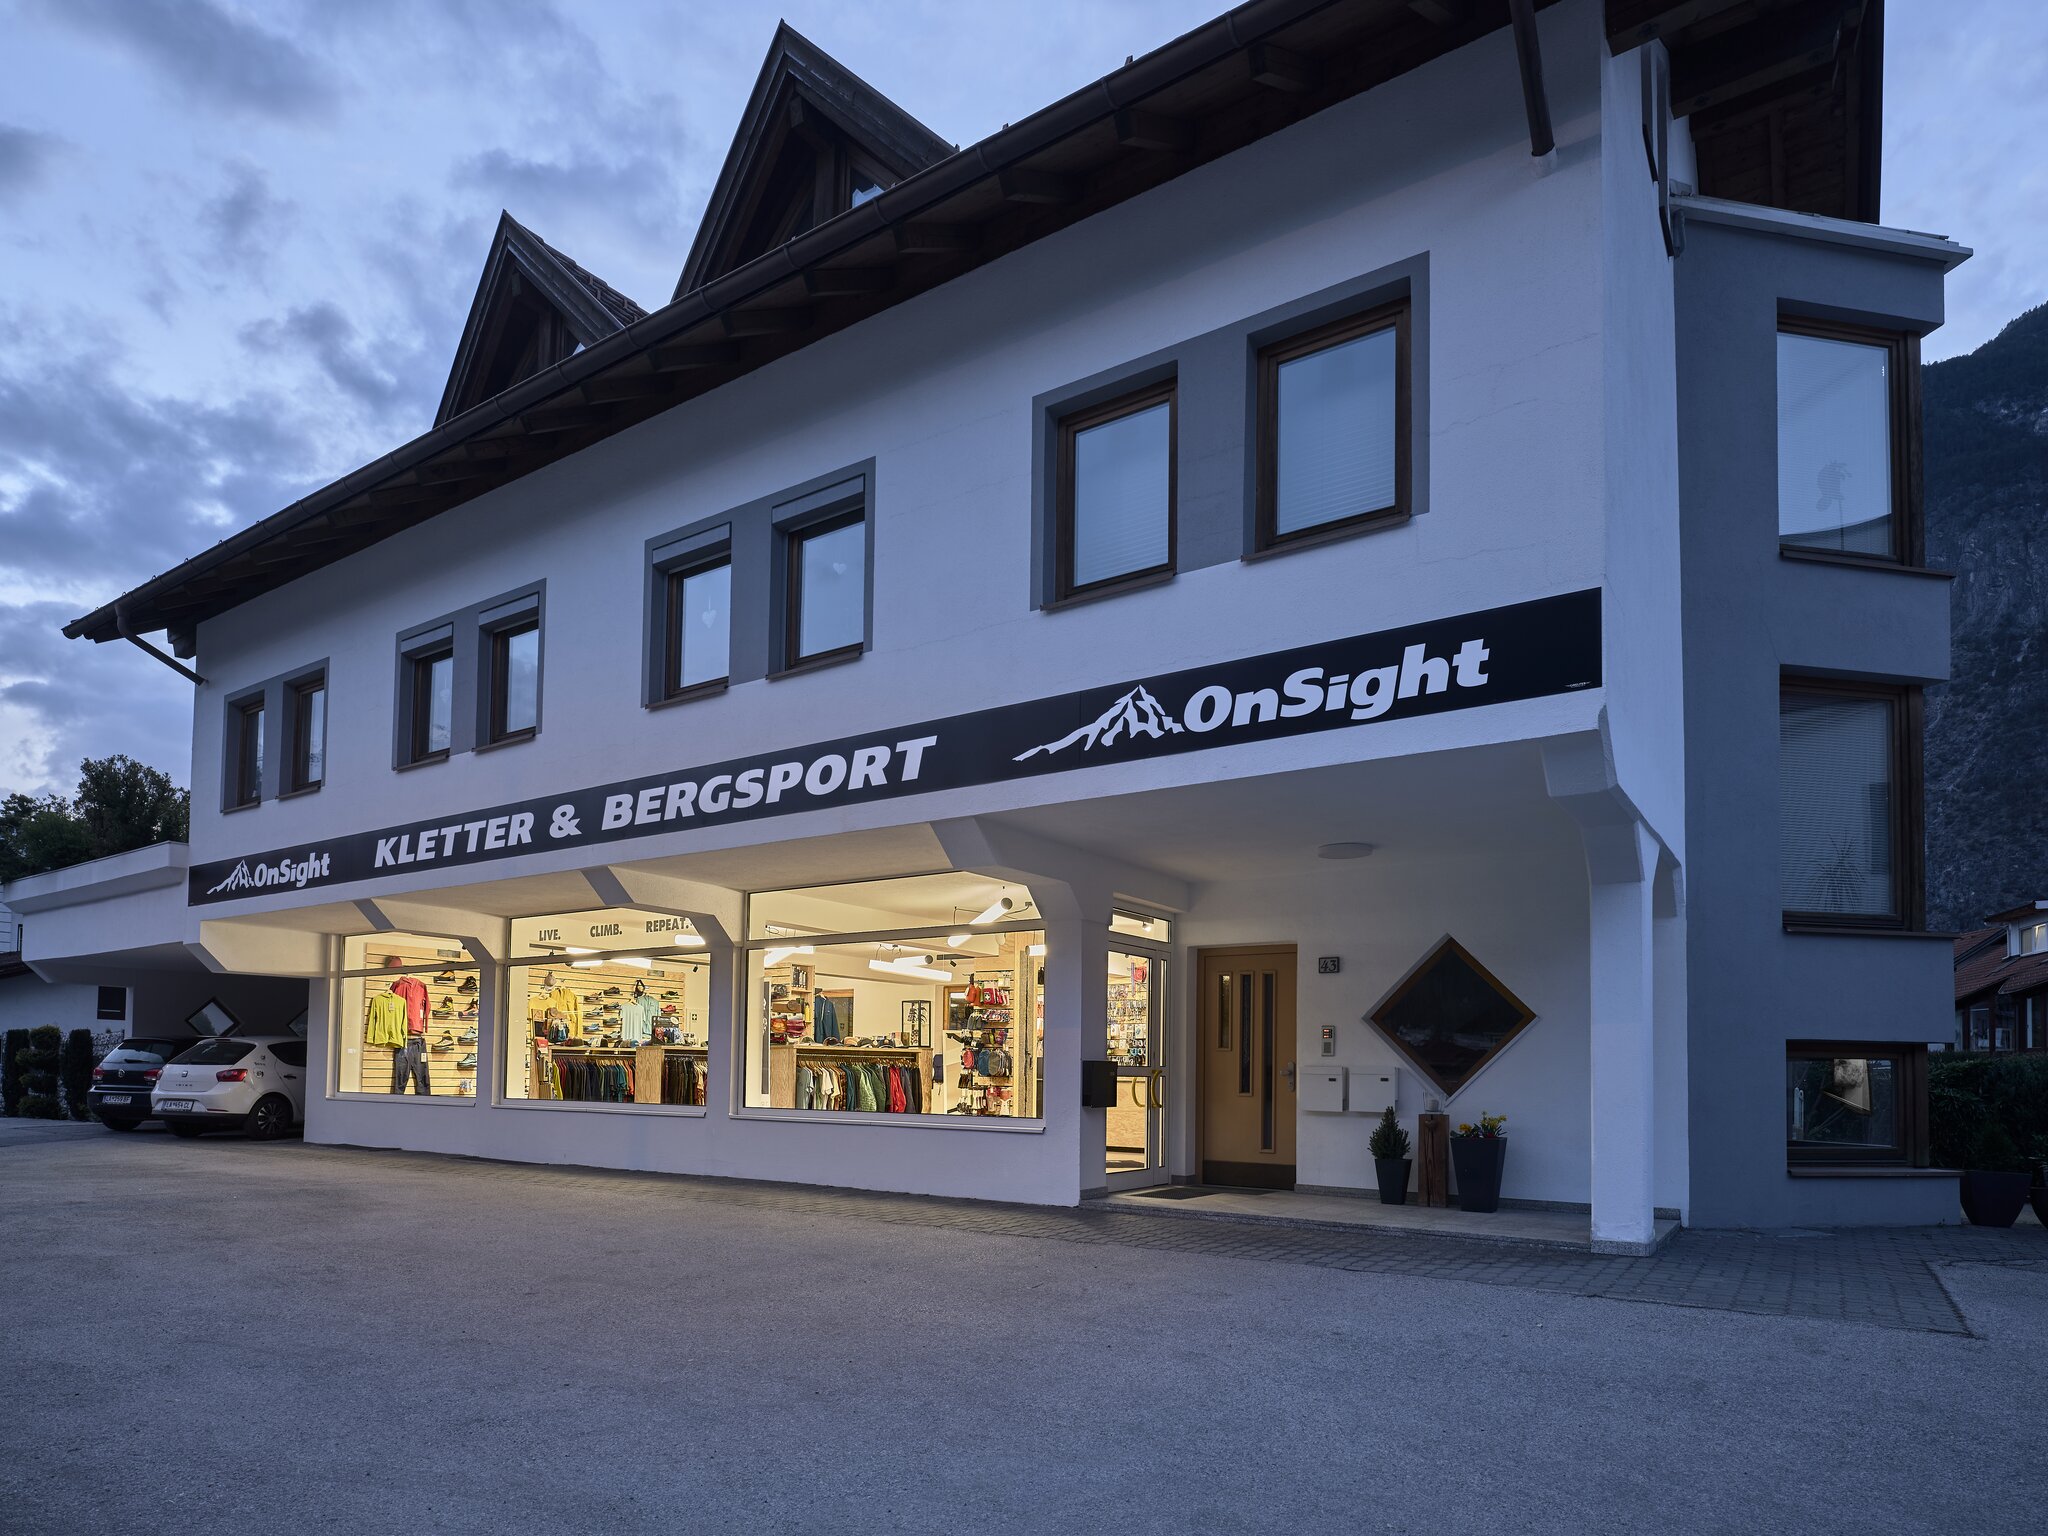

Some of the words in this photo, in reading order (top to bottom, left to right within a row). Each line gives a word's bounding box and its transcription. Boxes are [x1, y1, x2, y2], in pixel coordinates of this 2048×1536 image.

[1184, 639, 1490, 733] OnSight
[375, 812, 535, 868] KLETTER
[549, 804, 582, 839] &
[601, 735, 937, 831] BERGSPORT
[254, 852, 330, 887] OnSight
[539, 928, 561, 942] LIVE.
[590, 923, 623, 938] CLIMB.
[645, 917, 690, 933] REPEAT.
[1320, 959, 1337, 971] 43
